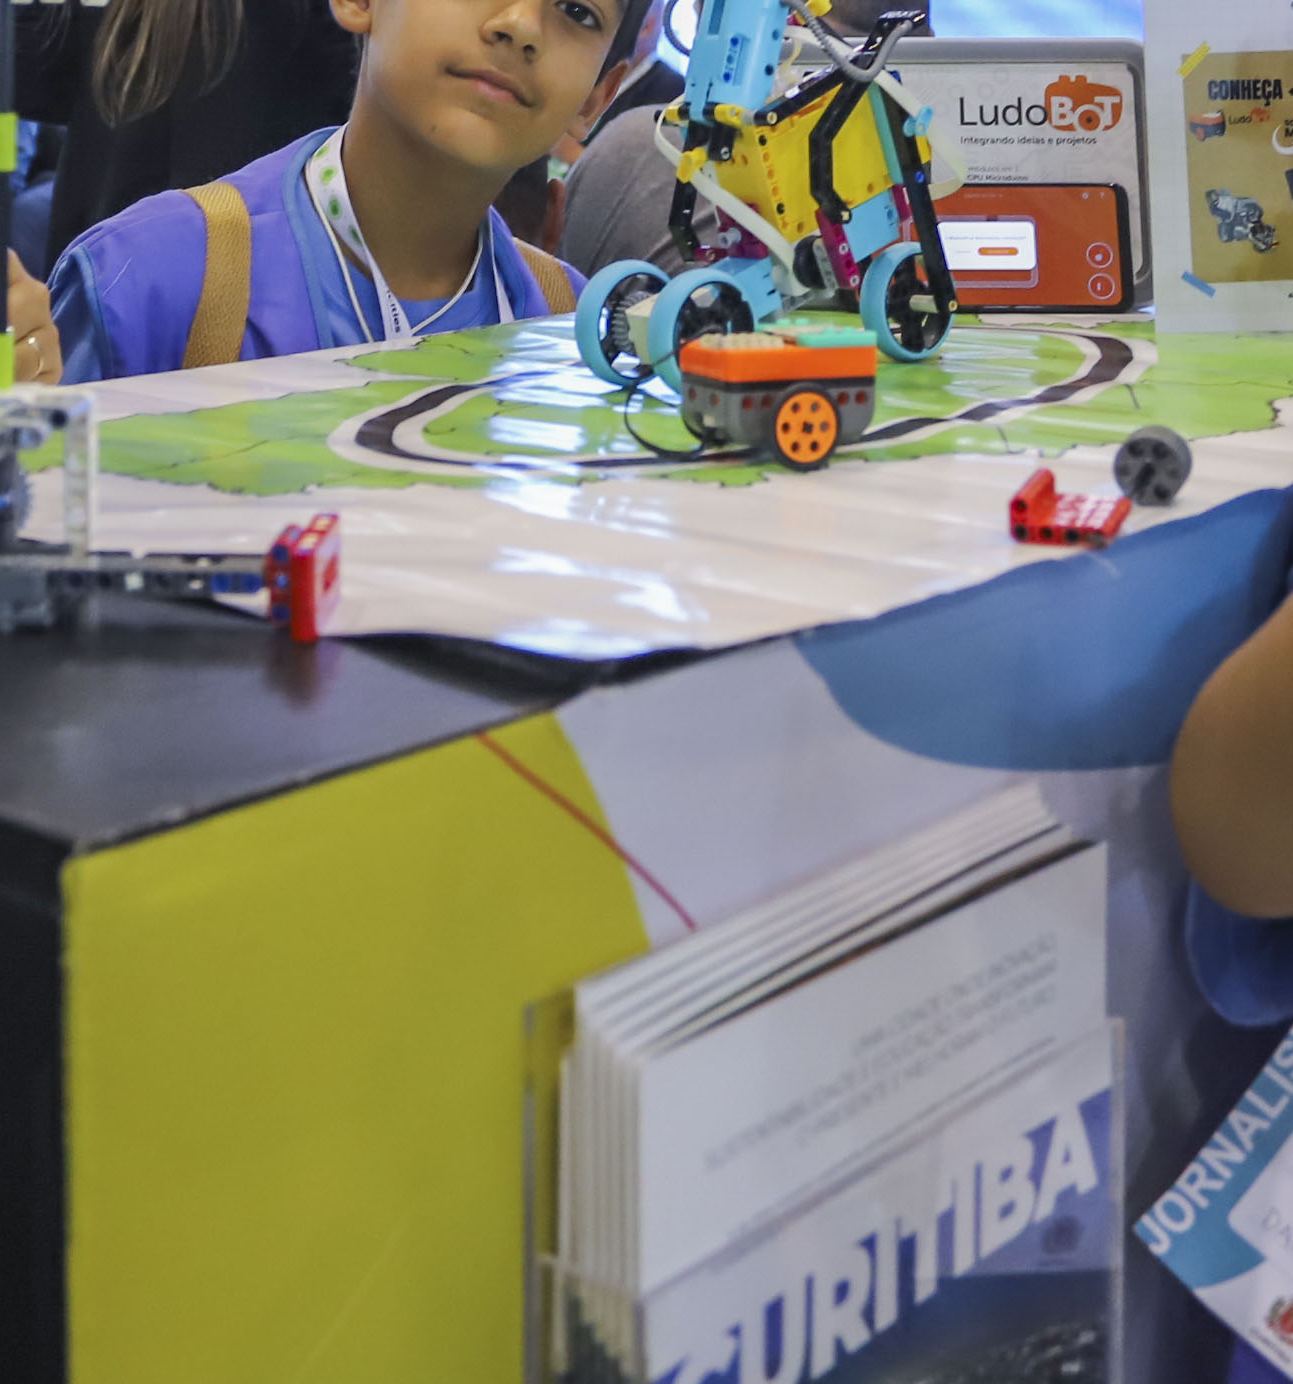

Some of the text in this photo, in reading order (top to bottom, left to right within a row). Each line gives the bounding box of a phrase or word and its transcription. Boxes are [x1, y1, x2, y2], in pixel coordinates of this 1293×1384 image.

[1208, 79, 1283, 106] CONHEÇA
[960, 135, 1097, 146] Integrando ideias e projetos
